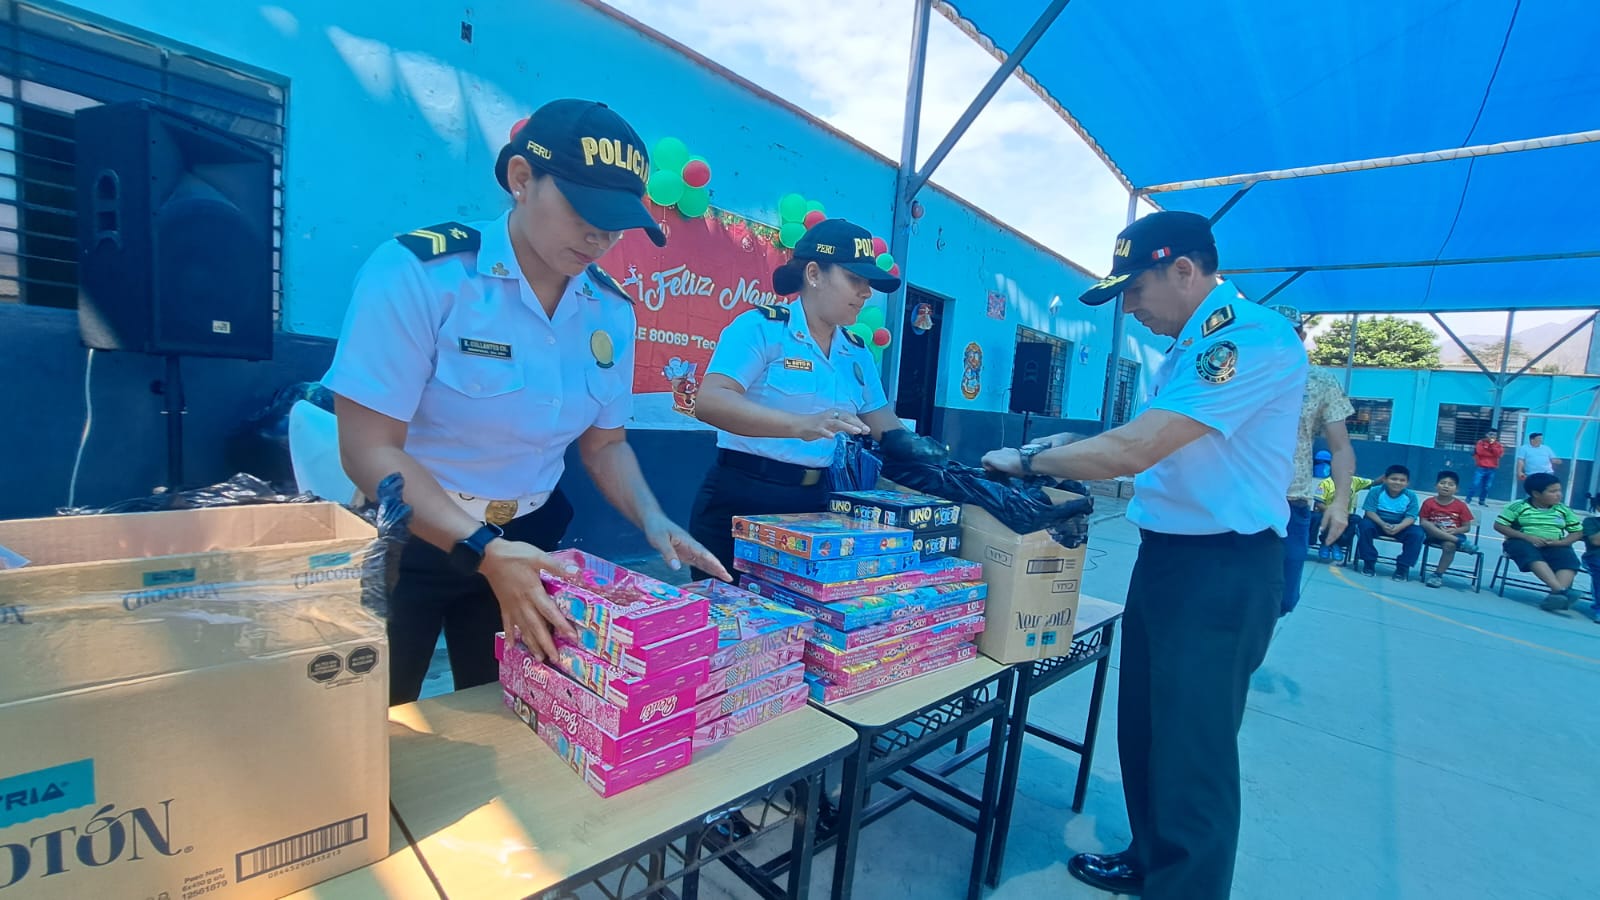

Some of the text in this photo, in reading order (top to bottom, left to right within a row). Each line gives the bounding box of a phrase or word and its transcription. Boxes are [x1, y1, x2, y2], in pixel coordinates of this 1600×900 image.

[527, 140, 551, 160] PERU
[816, 243, 835, 255] PERU
[649, 328, 689, 346] 80069
[831, 500, 851, 513] UNO
[908, 507, 932, 525] UNO
[522, 657, 549, 689] Beauty
[550, 700, 578, 735] Beauty
[639, 694, 679, 723] Beauty
